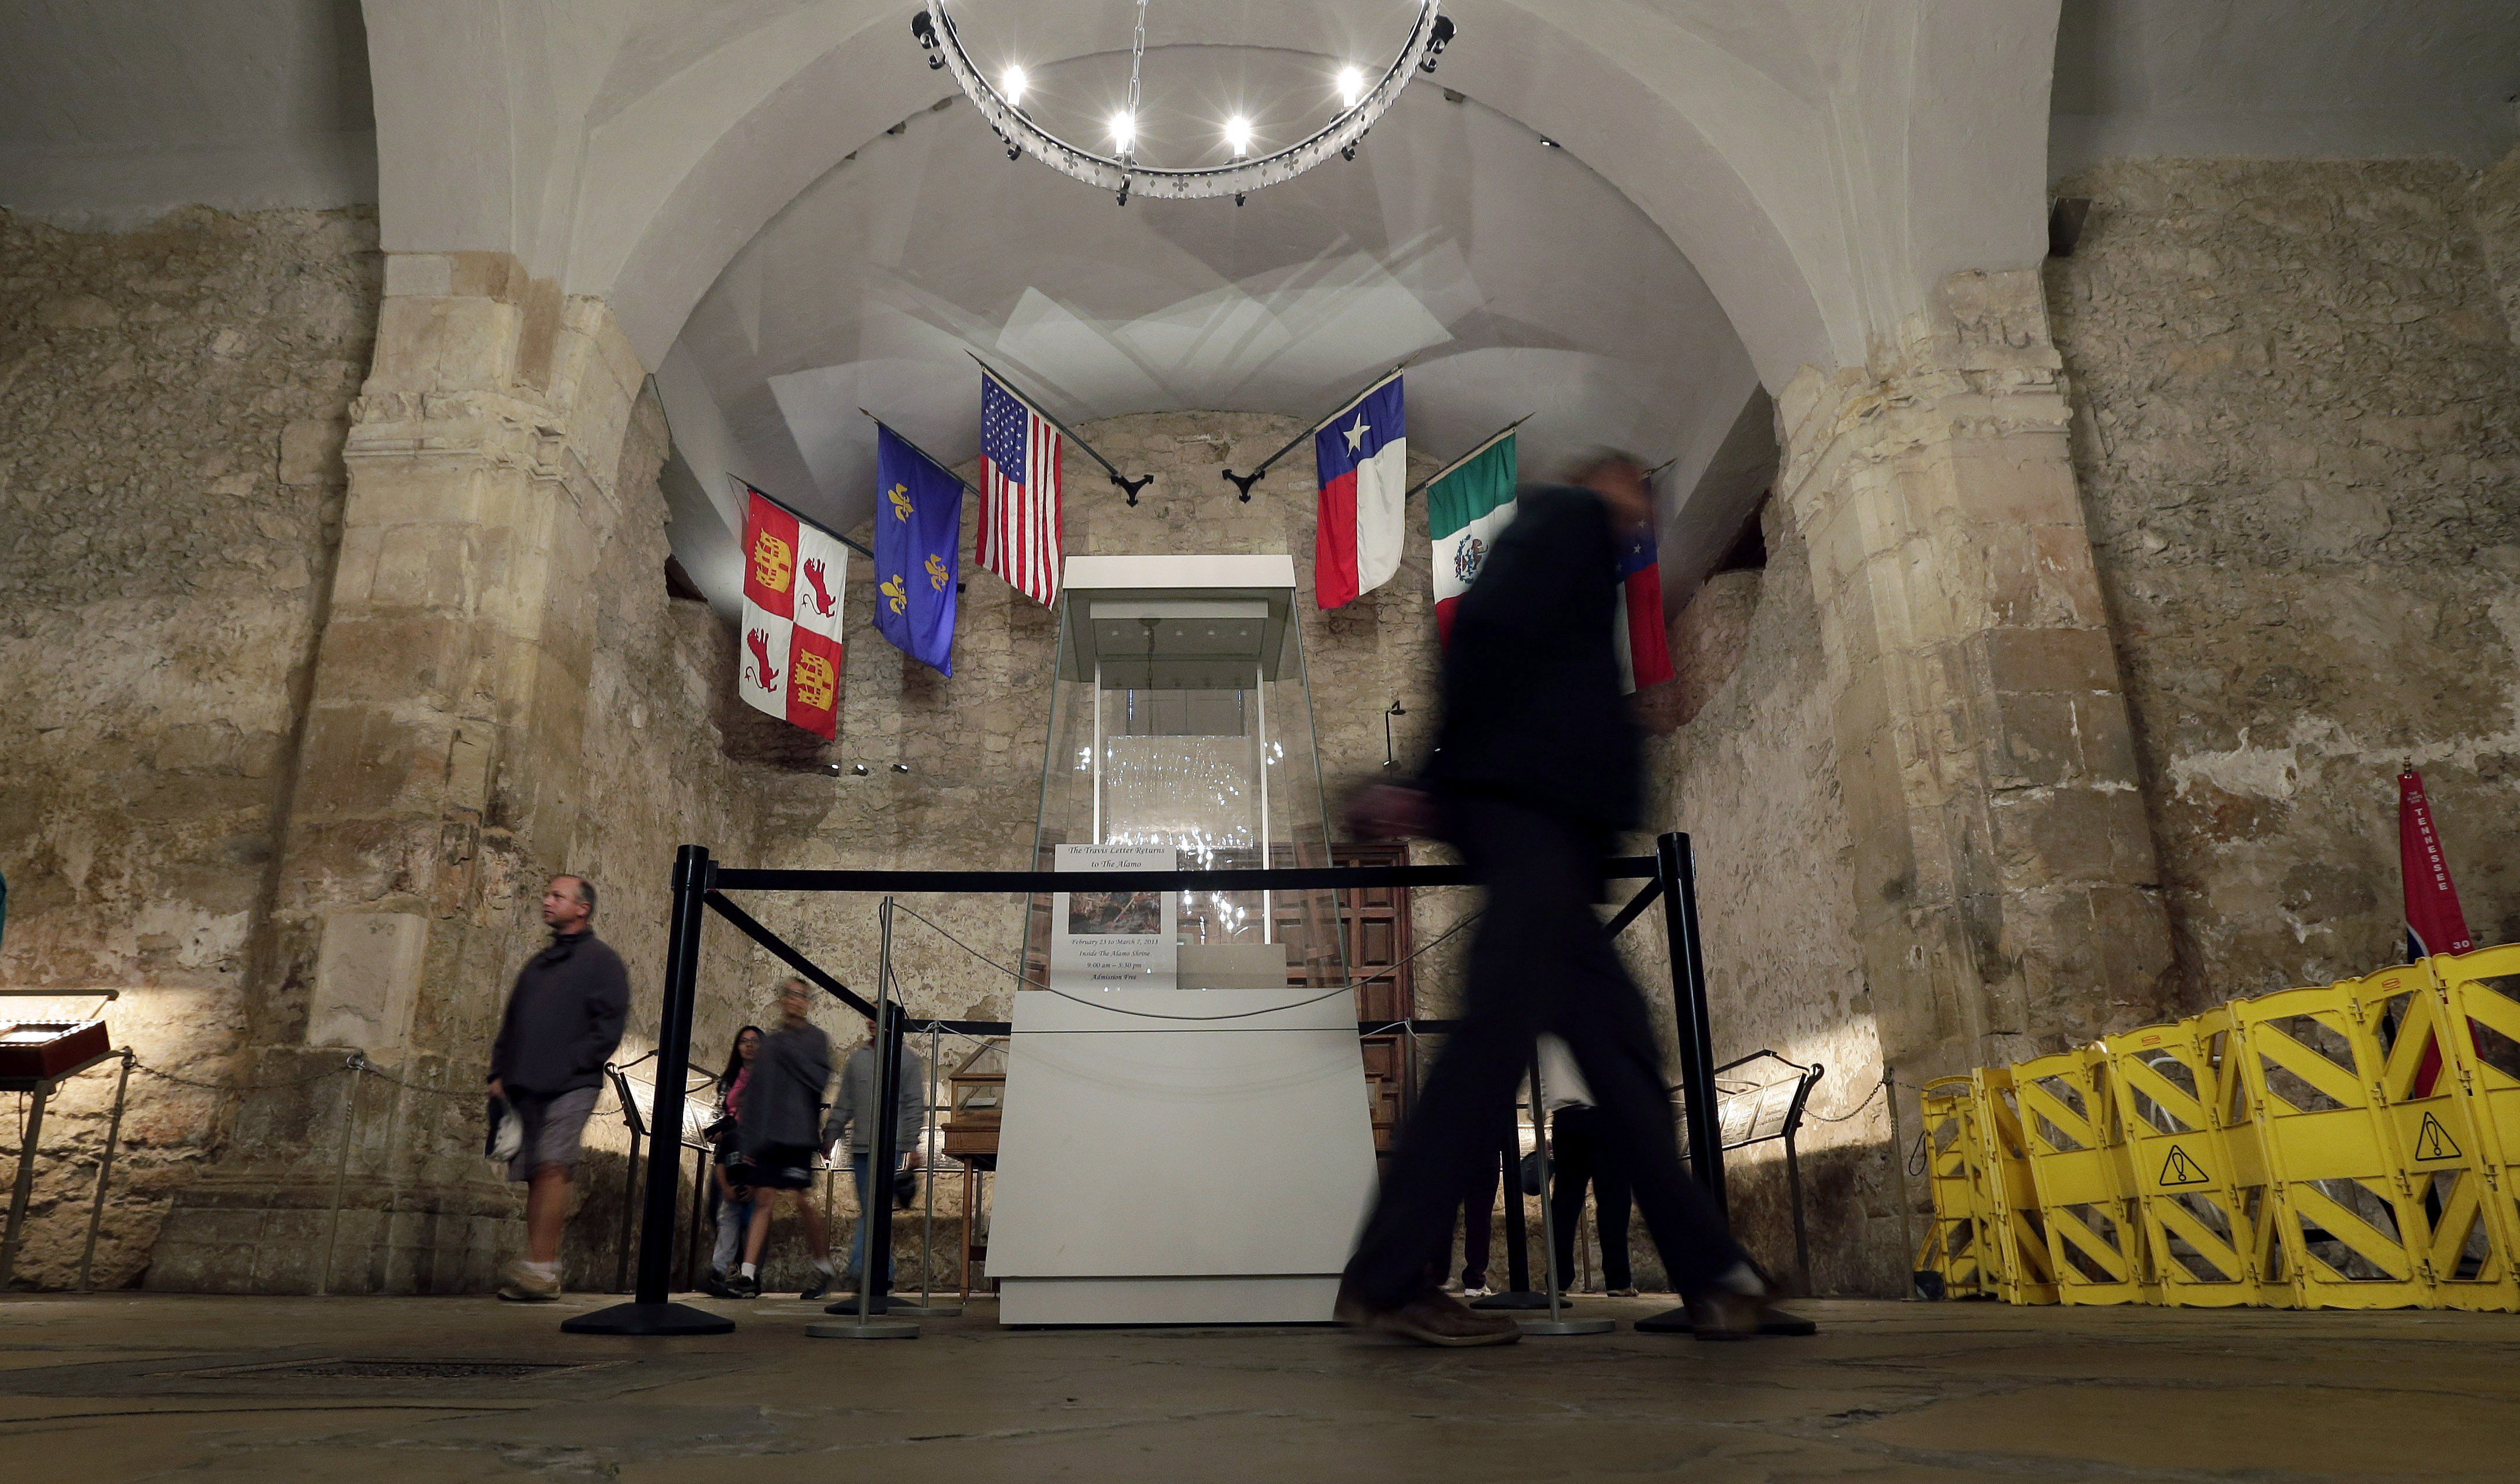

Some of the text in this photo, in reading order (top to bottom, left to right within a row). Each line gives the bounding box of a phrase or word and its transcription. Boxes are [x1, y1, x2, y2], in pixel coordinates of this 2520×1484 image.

[1135, 847, 1164, 855] Returns
[2414, 808, 2448, 890] TENNESSEE
[1115, 860, 1141, 868] Alamo
[2453, 940, 2470, 949] 30
